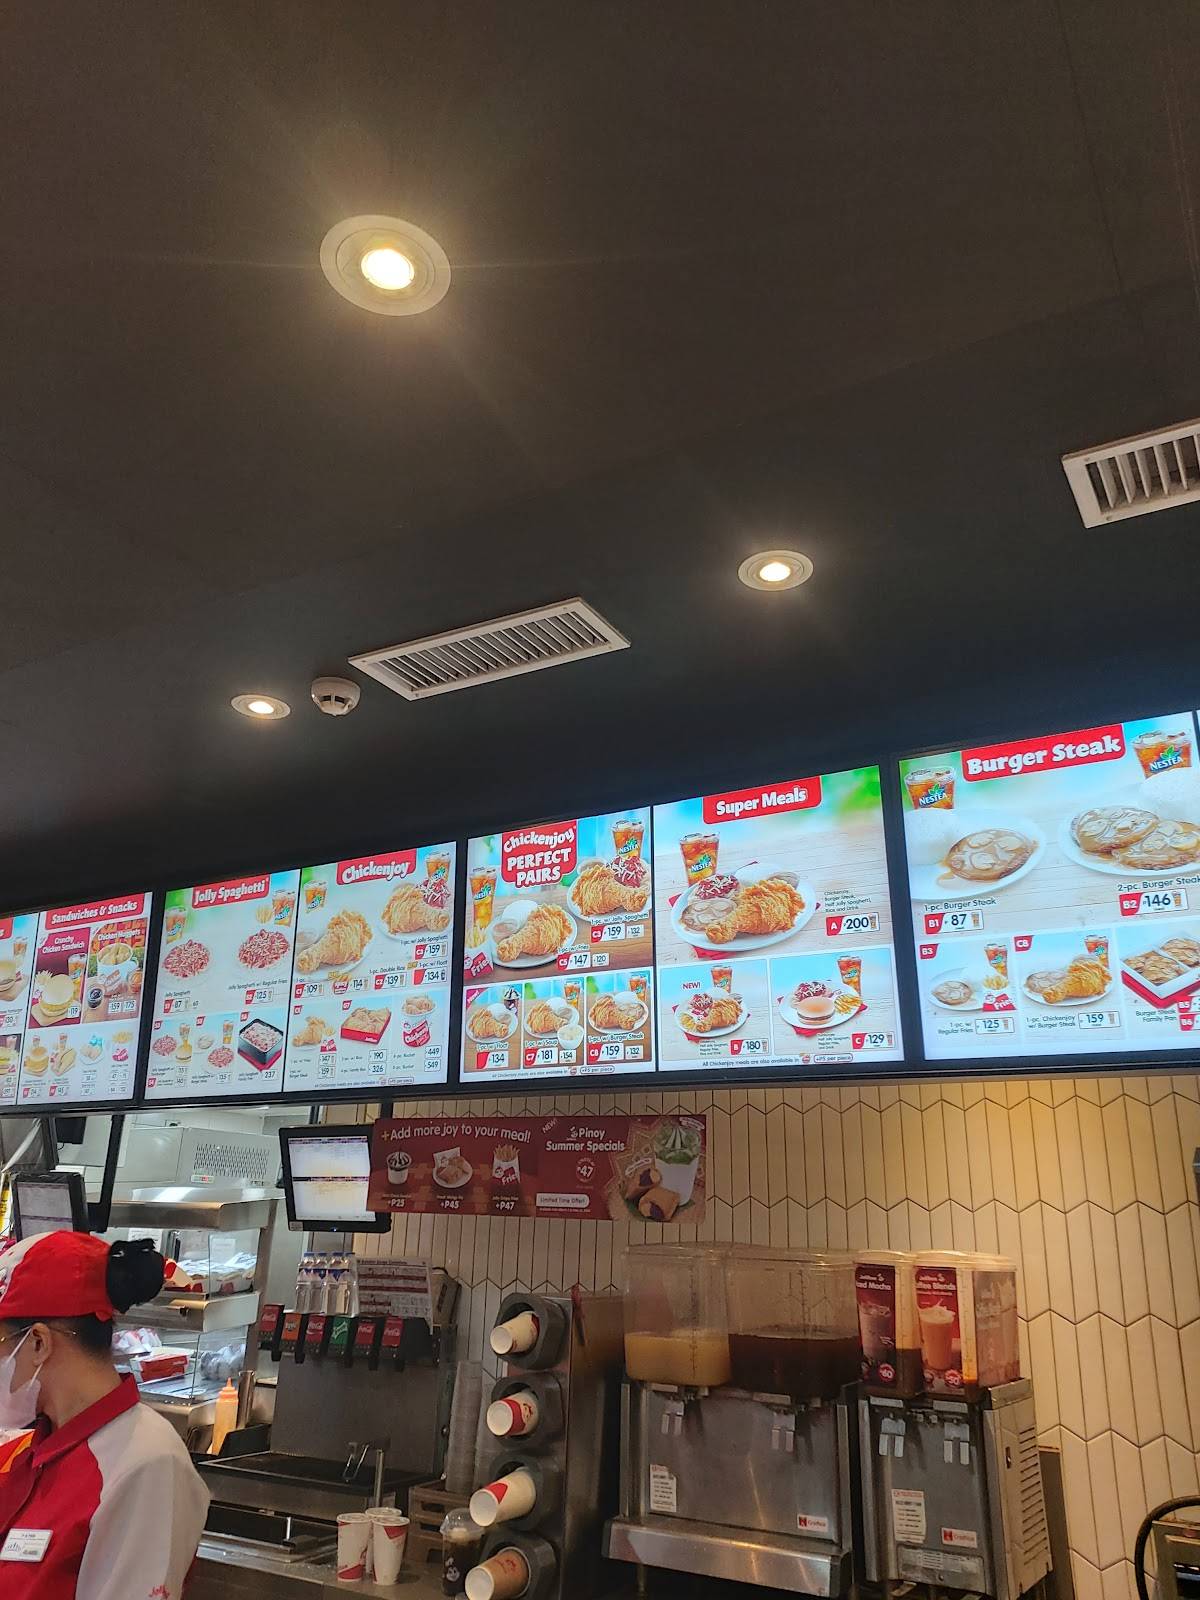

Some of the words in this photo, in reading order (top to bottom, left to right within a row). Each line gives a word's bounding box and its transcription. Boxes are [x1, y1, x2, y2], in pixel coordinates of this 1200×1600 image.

[967, 748, 1048, 775] Burger
[1052, 735, 1122, 760] Steak
[1150, 756, 1183, 772] NESTEA
[716, 798, 760, 816] Super
[762, 787, 808, 807] Meals
[919, 792, 949, 805] NESTEA
[504, 827, 575, 853] Chickenjoy
[507, 848, 572, 871] PERFECT
[342, 861, 410, 883] Chickenjoy
[516, 866, 561, 886] PAIRS
[1142, 880, 1173, 891] Burger
[194, 890, 216, 905] Jolly
[218, 880, 265, 898] Spaghetti
[944, 901, 971, 911] Burger
[973, 898, 996, 906] Steak
[1122, 898, 1137, 910] B2
[1146, 894, 1171, 907] 146
[51, 908, 98, 924] Sandwiches
[108, 901, 137, 915] Snacks
[846, 917, 869, 929] 200
[951, 914, 966, 926] 87
[607, 926, 621, 937] 159
[574, 955, 588, 964] 147
[982, 1020, 999, 1029] 125
[1086, 1014, 1104, 1023] 159
[746, 1040, 761, 1050] 180
[868, 1034, 884, 1044] 129
[606, 1046, 620, 1055] 159
[491, 1054, 505, 1063] 134
[413, 1125, 440, 1136] more
[441, 1125, 457, 1136] joy
[475, 1127, 498, 1138] your
[501, 1129, 531, 1143] meal!
[579, 1128, 605, 1139] Pinoy
[546, 1140, 585, 1151] Summer
[587, 1140, 625, 1153] Specials
[868, 1283, 891, 1291] Mocha
